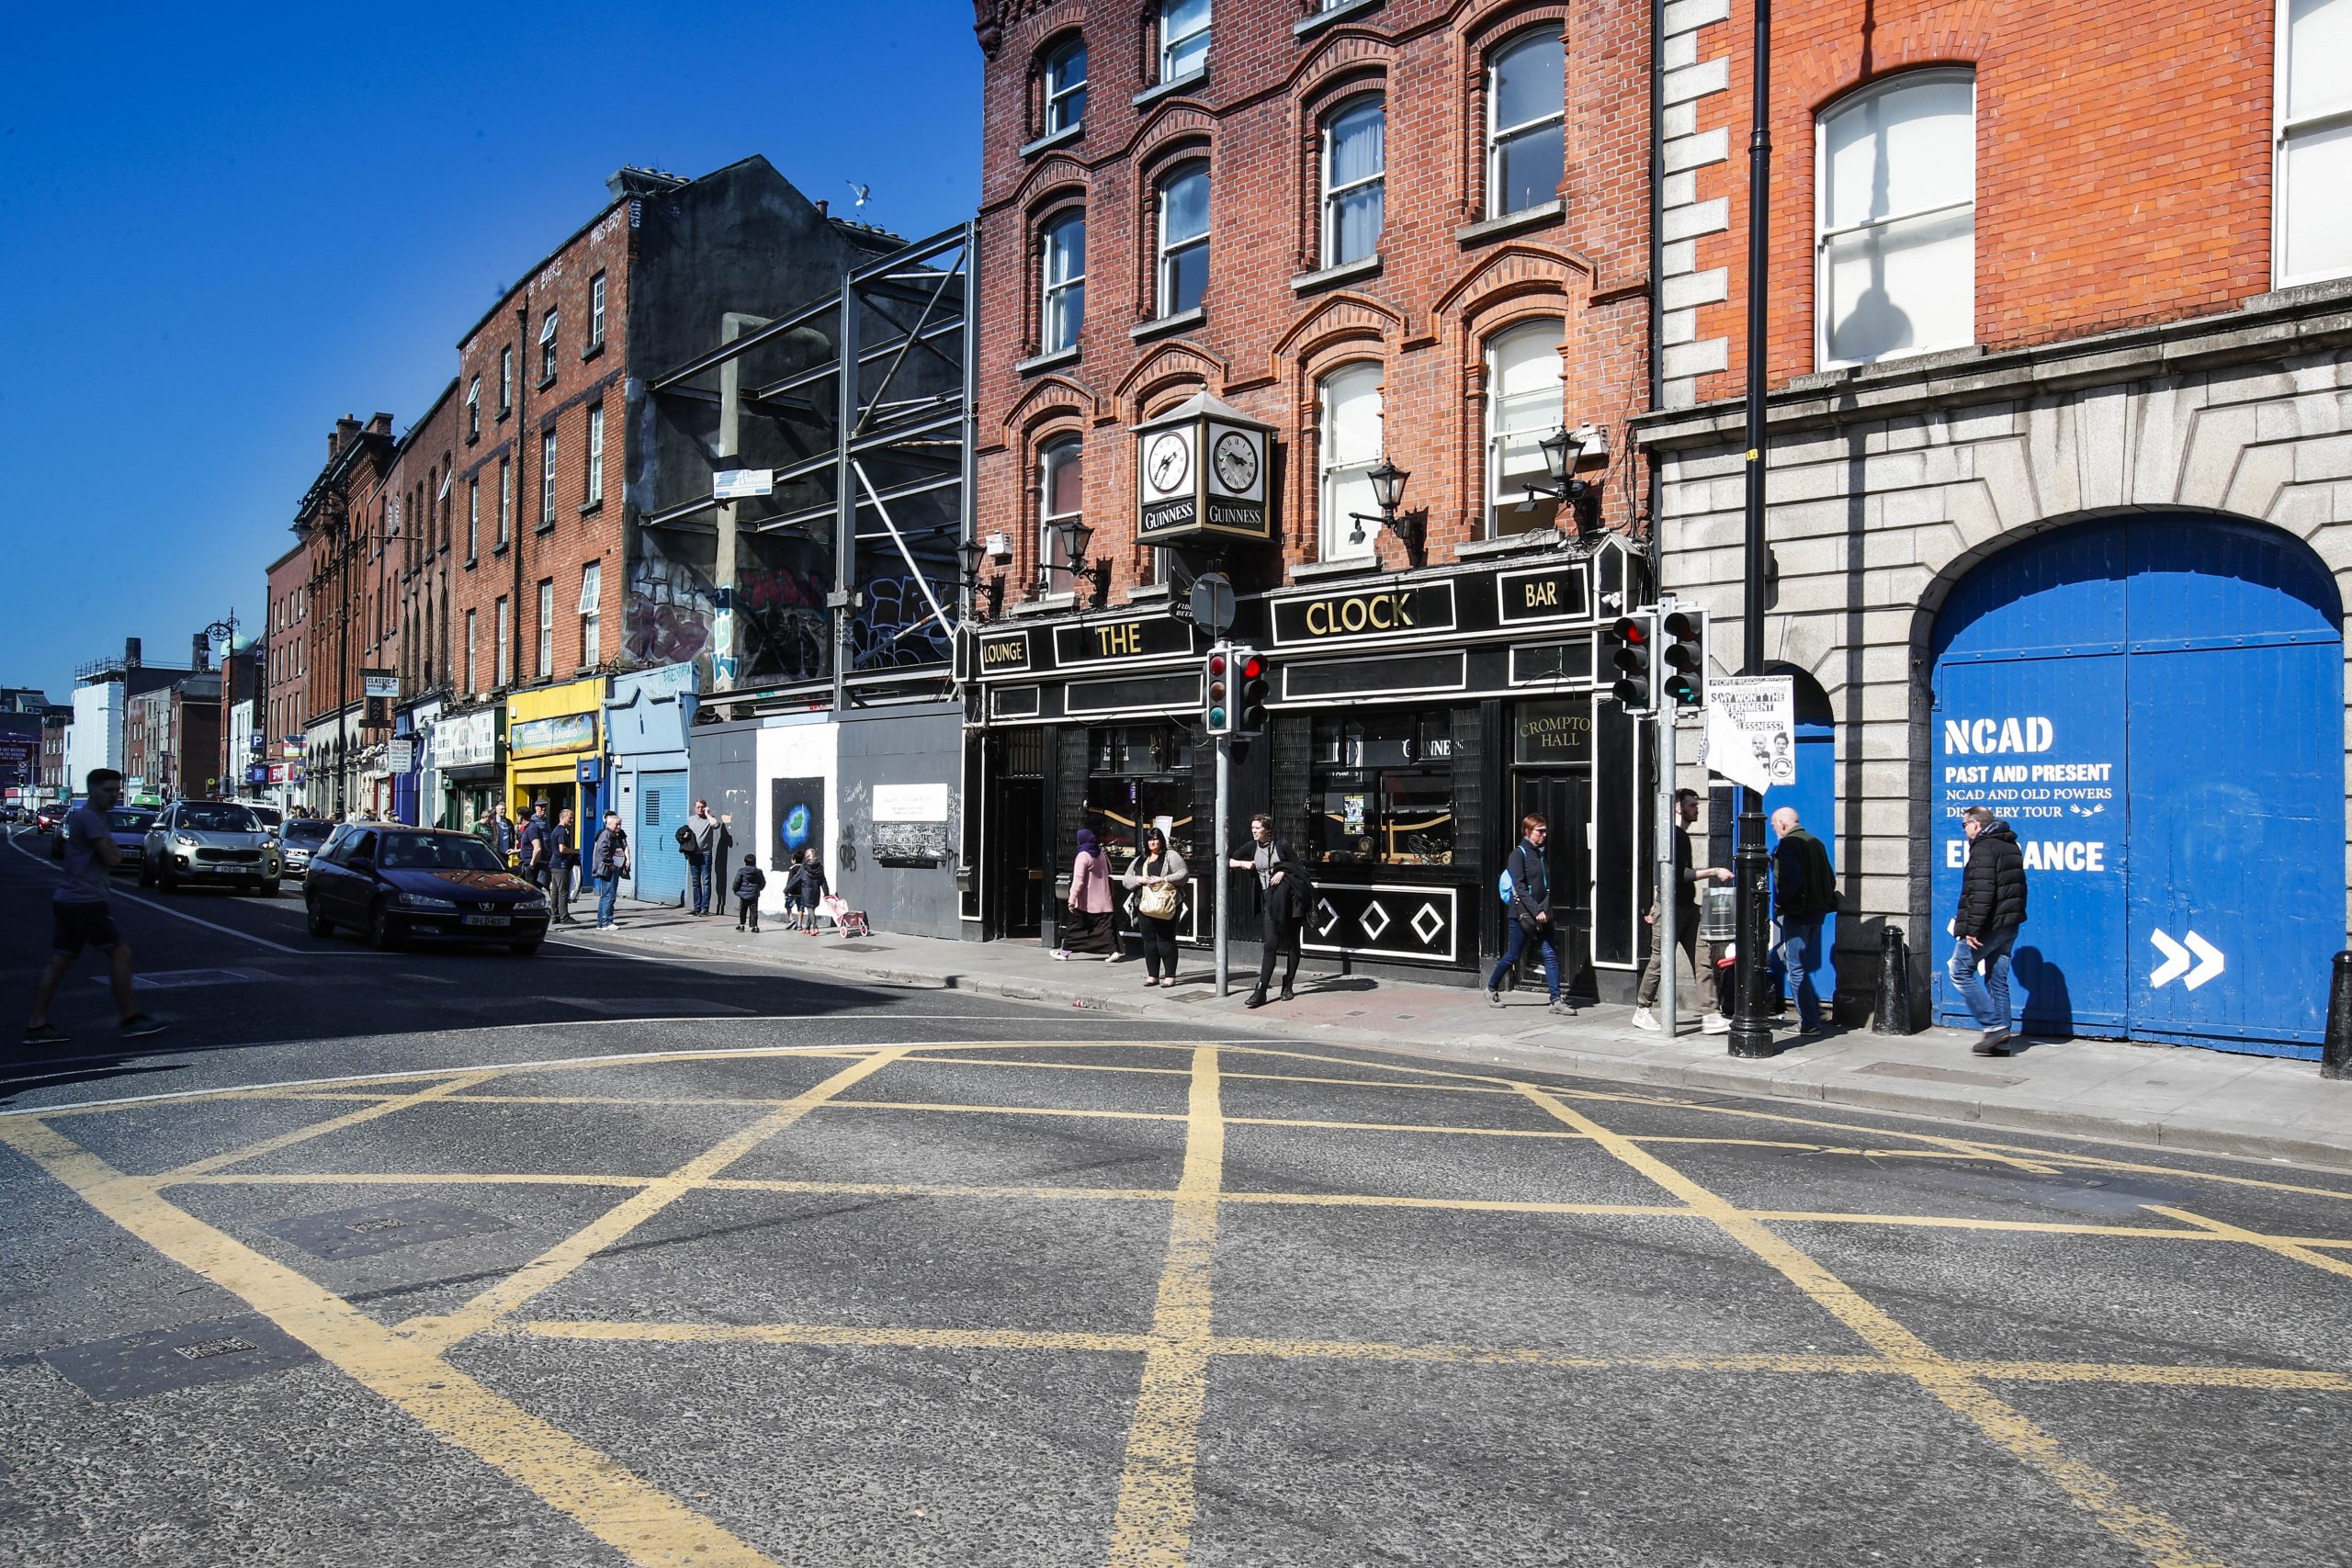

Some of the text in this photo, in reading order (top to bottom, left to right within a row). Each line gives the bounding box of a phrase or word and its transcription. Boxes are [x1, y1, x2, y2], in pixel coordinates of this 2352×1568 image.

[1145, 502, 1194, 530] GUINNESS
[1209, 505, 1261, 524] GUINNESS
[1525, 581, 1559, 608] BAR
[1306, 592, 1415, 636] CLOCK
[1097, 623, 1142, 656] THE
[983, 641, 1023, 664] LOUNGE
[1724, 703, 1773, 712] VERNMENT
[1735, 693, 1765, 703] WON'T
[1768, 693, 1784, 702] THE
[553, 724, 578, 740] Studio
[1520, 716, 1592, 738] CROMPTO
[1945, 716, 2054, 754] NCAD
[254, 736, 263, 747] P
[1541, 733, 1580, 747] HALL
[1945, 763, 2112, 784] PAST AND PRESENT
[1946, 787, 2112, 800] NCAD AND OLD POWERS
[1946, 807, 2063, 818] DISLERY TOUR
